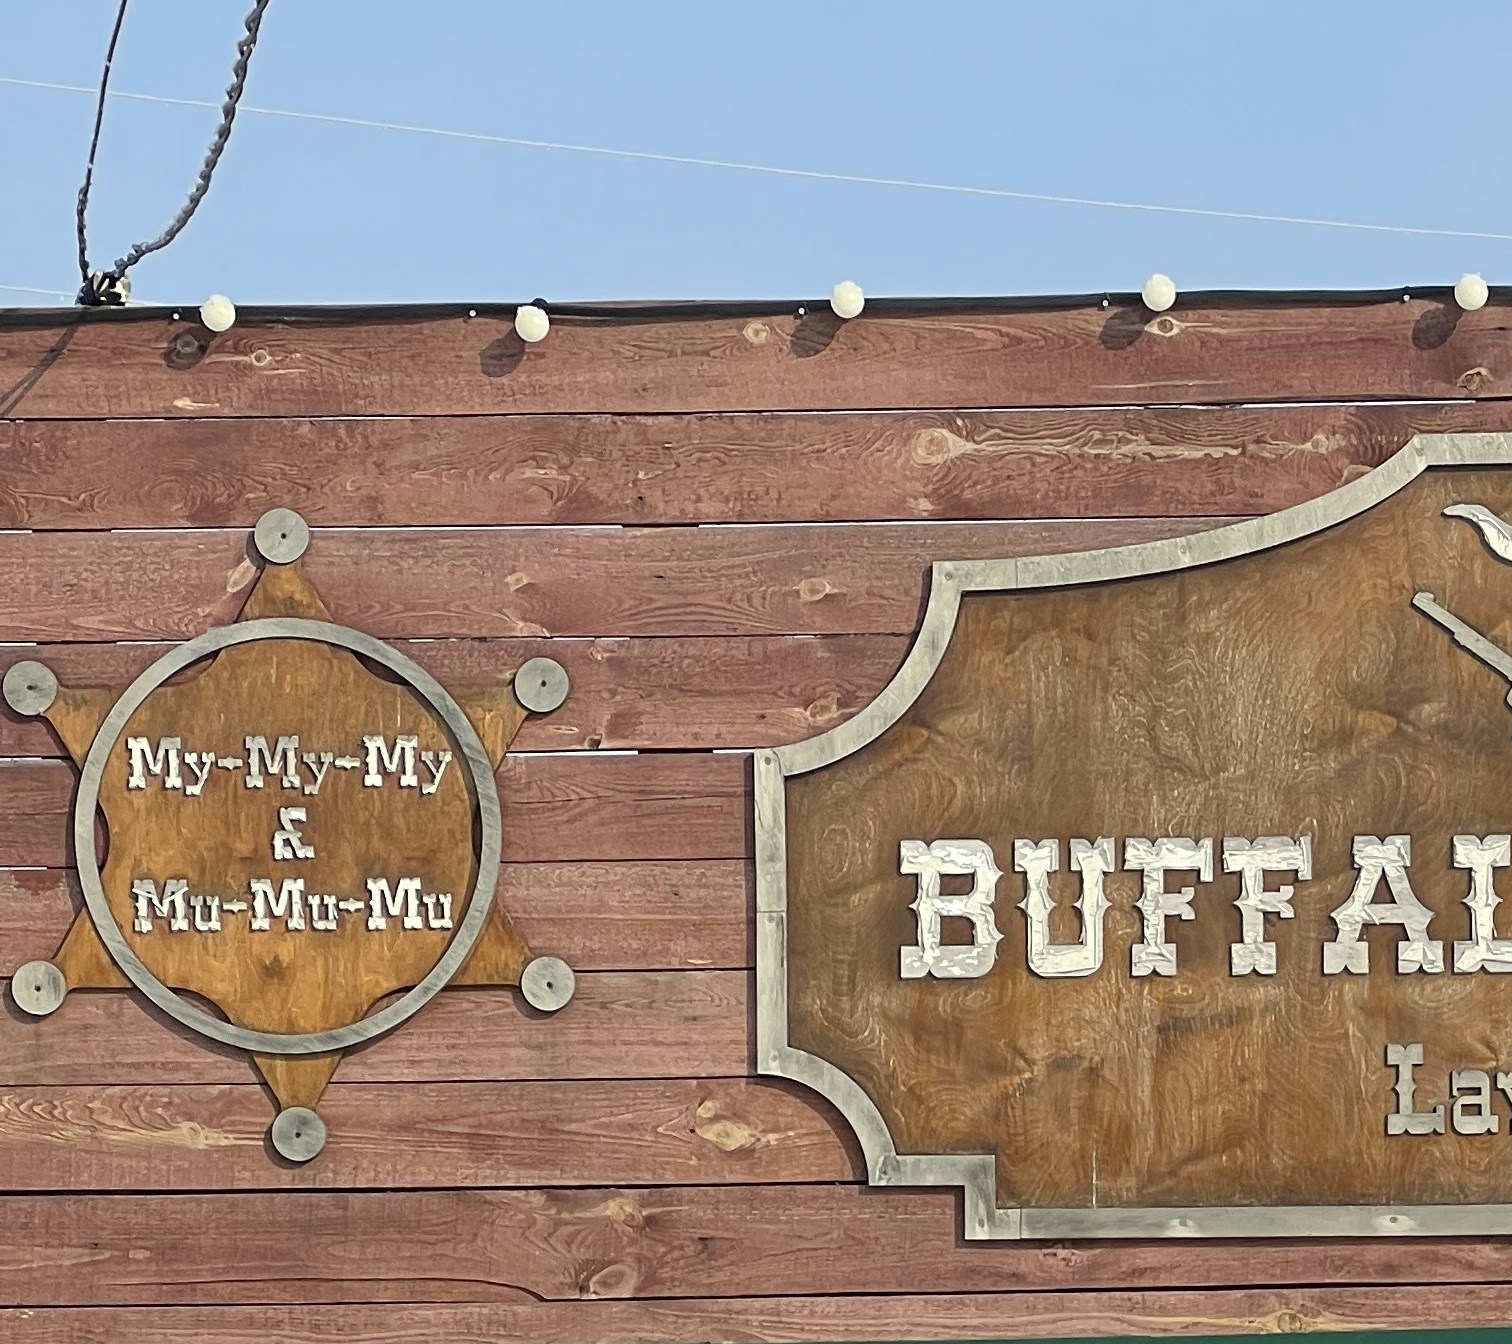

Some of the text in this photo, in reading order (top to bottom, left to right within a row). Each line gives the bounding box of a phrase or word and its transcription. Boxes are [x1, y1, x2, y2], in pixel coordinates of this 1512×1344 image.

[127, 735, 453, 795] My-My-My
[273, 807, 315, 859] &
[132, 878, 453, 933] Mu-Mu-Mu
